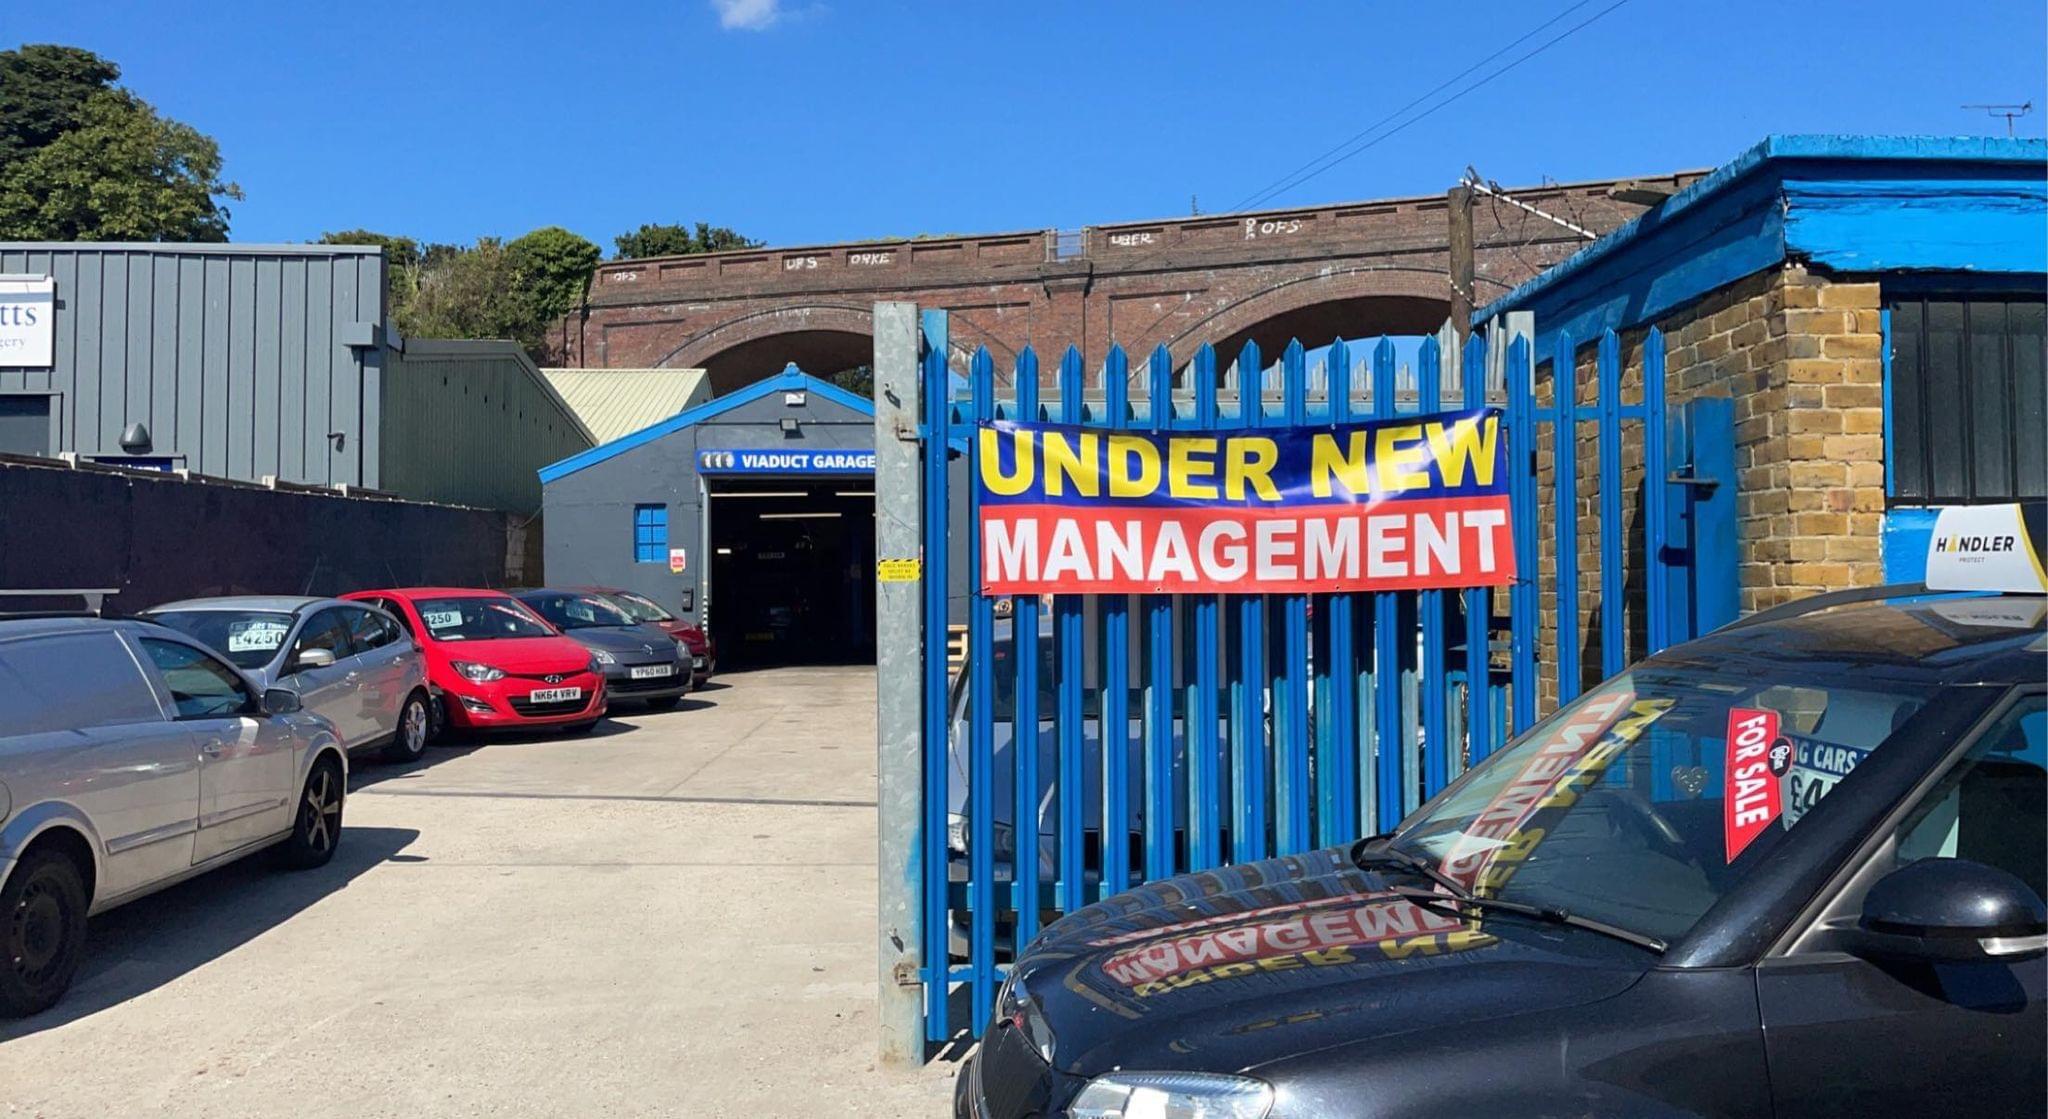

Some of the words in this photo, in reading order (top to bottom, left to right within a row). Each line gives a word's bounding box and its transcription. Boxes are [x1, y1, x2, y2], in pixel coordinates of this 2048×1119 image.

[742, 454, 809, 469] VIADUCT
[813, 454, 876, 469] GARAGE
[979, 427, 1281, 501] UNDER
[1310, 416, 1498, 500] NEW
[984, 510, 1507, 583] MANAGEMENT
[533, 689, 558, 701] NK64
[559, 687, 578, 699] VRV
[1735, 714, 1767, 762] FOR
[1813, 745, 1857, 774] CARS
[1734, 762, 1770, 828] SALE
